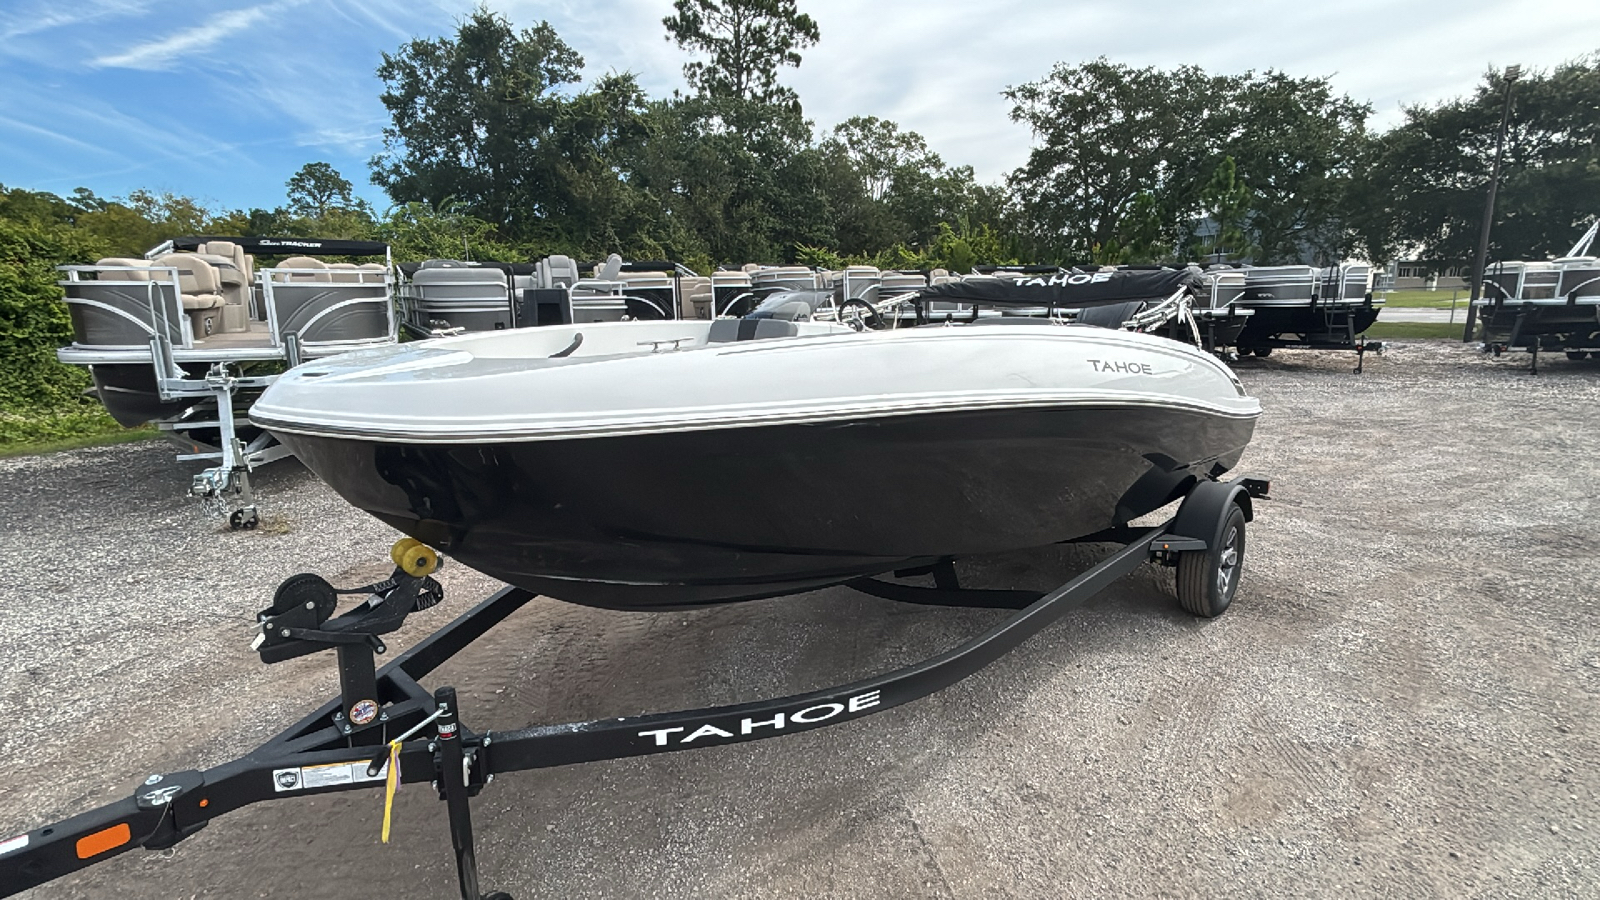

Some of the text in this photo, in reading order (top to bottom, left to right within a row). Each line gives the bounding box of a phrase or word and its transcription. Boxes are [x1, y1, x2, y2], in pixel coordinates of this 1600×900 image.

[1012, 271, 1114, 288] TAHOE
[1086, 359, 1153, 375] TAHOE
[638, 689, 881, 746] TAHOE
